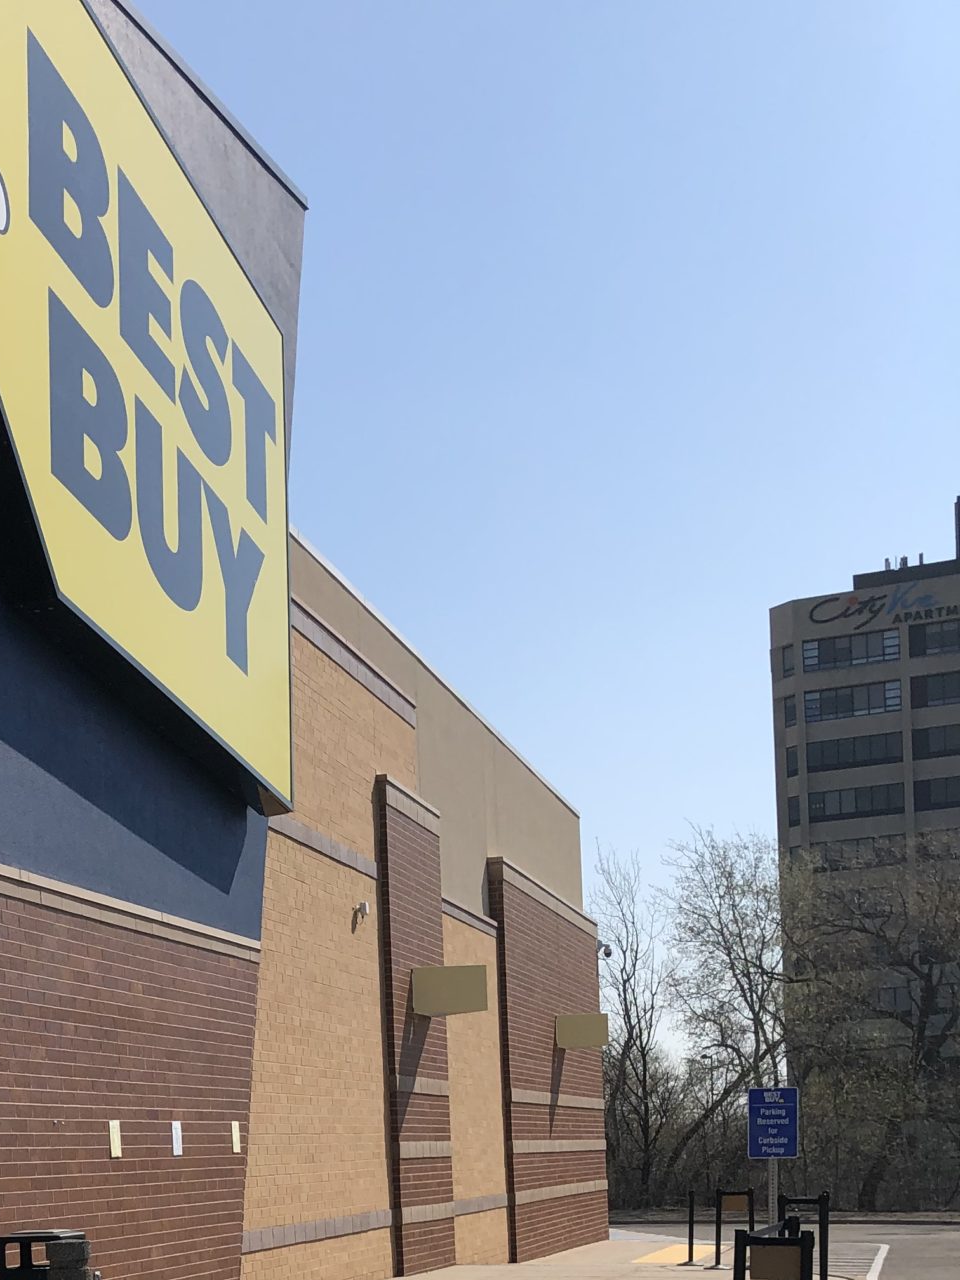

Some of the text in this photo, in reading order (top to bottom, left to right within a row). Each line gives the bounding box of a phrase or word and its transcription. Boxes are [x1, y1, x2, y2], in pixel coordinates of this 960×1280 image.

[27, 25, 277, 524] BEST
[47, 286, 266, 677] BUY
[760, 1108, 786, 1117] Parking
[756, 1117, 789, 1125] Reserved
[758, 1136, 788, 1144] Curbside
[762, 1146, 784, 1155] Pickup
